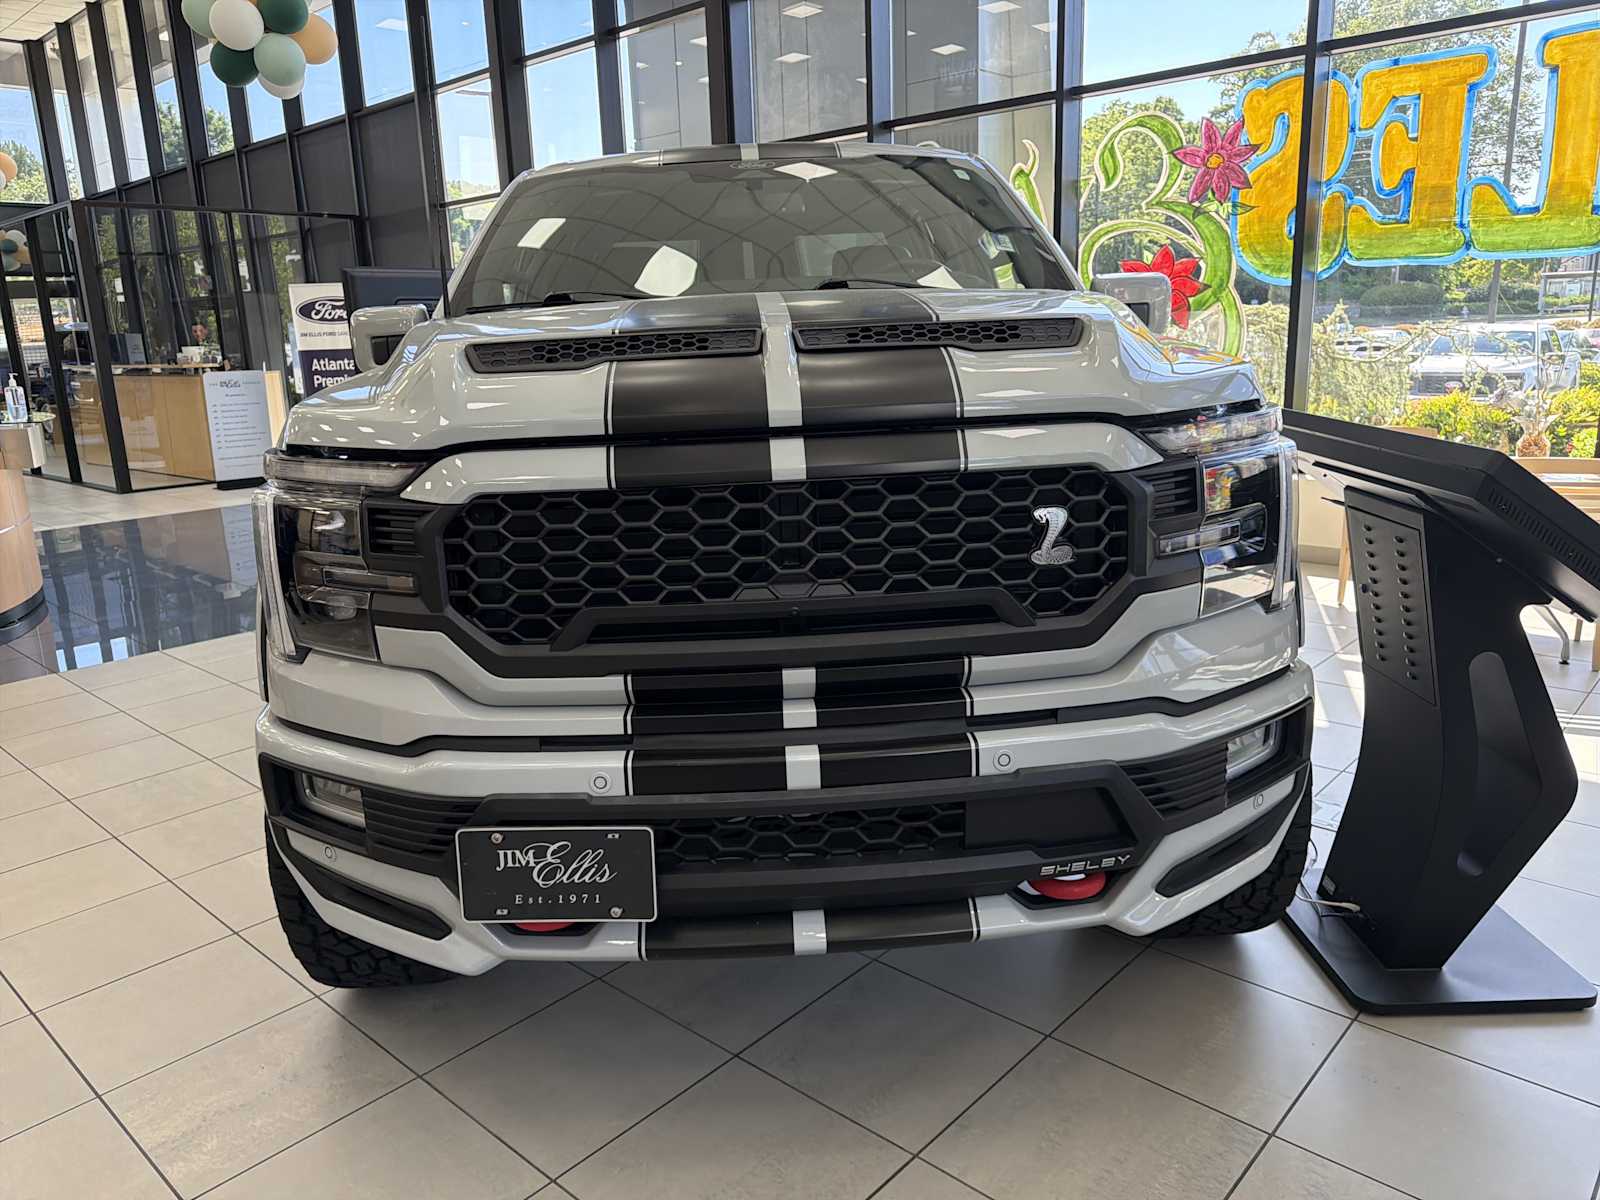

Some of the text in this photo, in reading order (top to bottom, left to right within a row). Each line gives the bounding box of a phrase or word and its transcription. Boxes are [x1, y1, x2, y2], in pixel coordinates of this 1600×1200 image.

[496, 841, 618, 888] JIM Ellis
[1040, 854, 1131, 876] SHELBY
